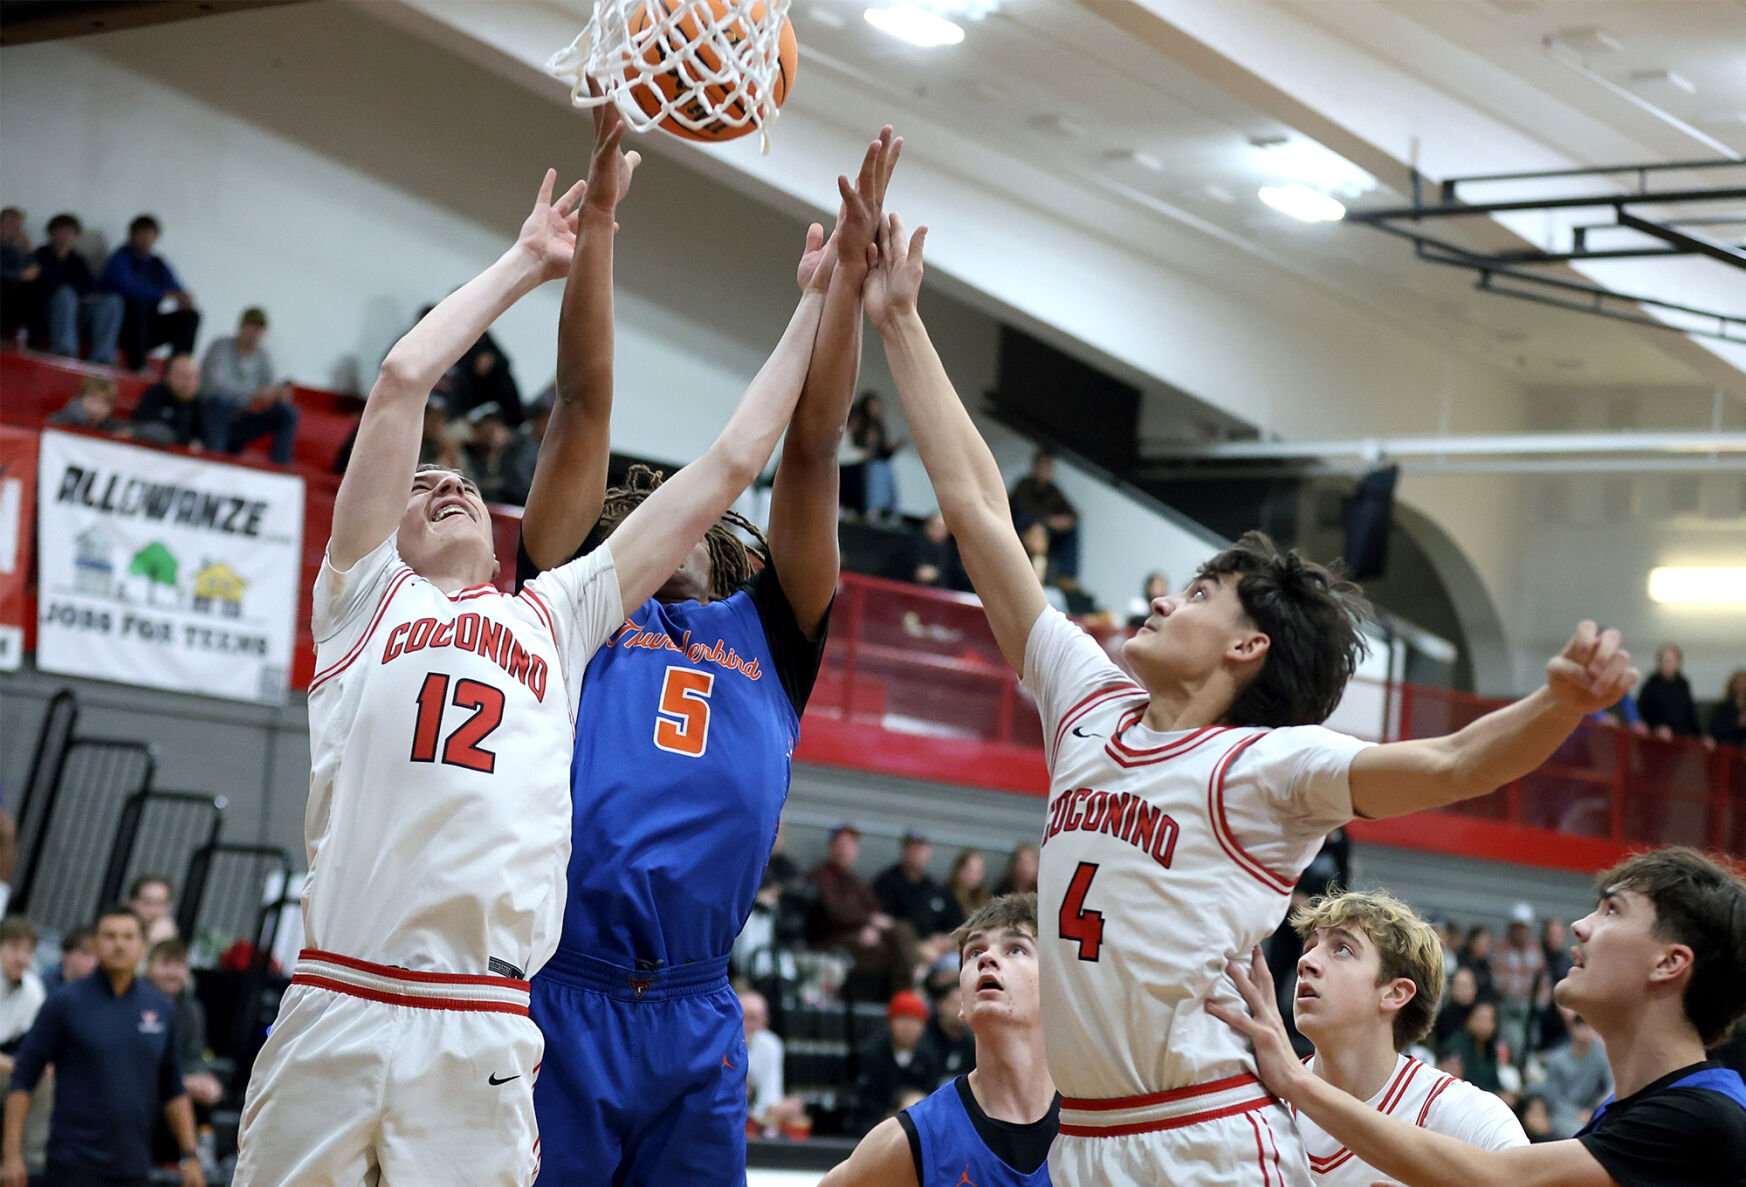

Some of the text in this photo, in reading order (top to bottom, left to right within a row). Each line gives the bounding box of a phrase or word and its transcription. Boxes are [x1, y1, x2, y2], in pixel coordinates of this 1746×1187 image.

[46, 603, 269, 655] JOBS FOR TEENS
[381, 612, 549, 704] COCONINO
[410, 672, 506, 775] 12
[653, 665, 715, 758] 5
[1059, 861, 1106, 962] 4
